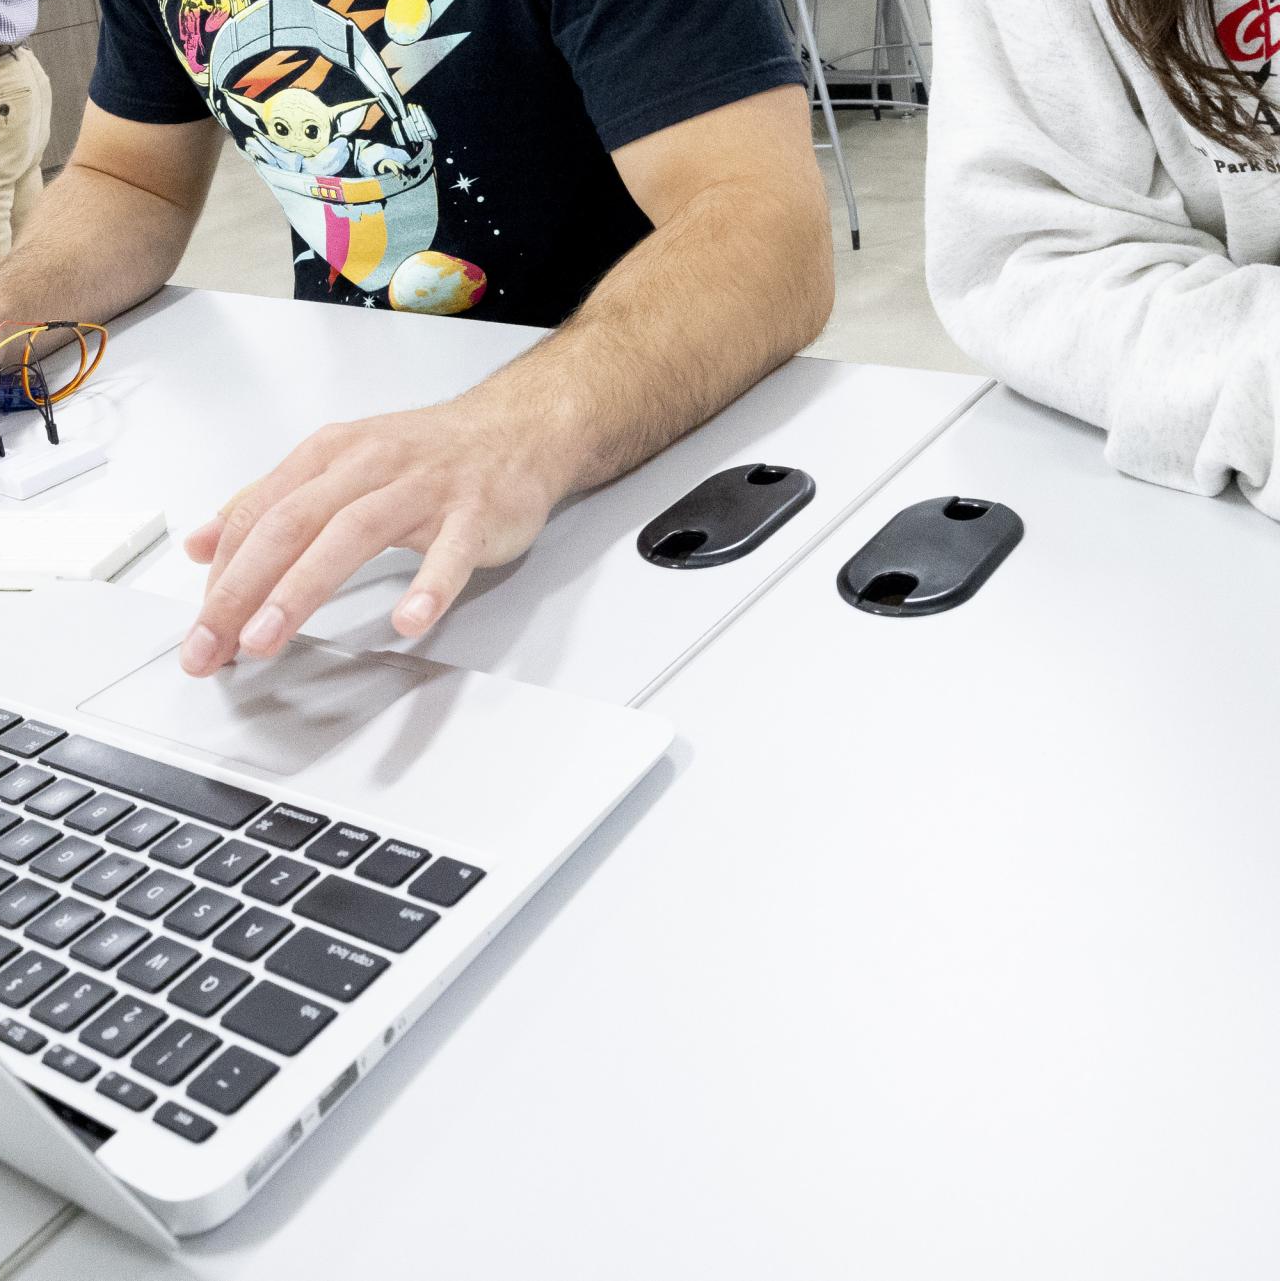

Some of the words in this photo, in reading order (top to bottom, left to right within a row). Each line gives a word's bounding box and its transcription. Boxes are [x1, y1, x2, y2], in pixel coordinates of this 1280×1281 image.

[1213, 158, 1262, 174] Park
[273, 804, 321, 824] command
[339, 825, 371, 842] option
